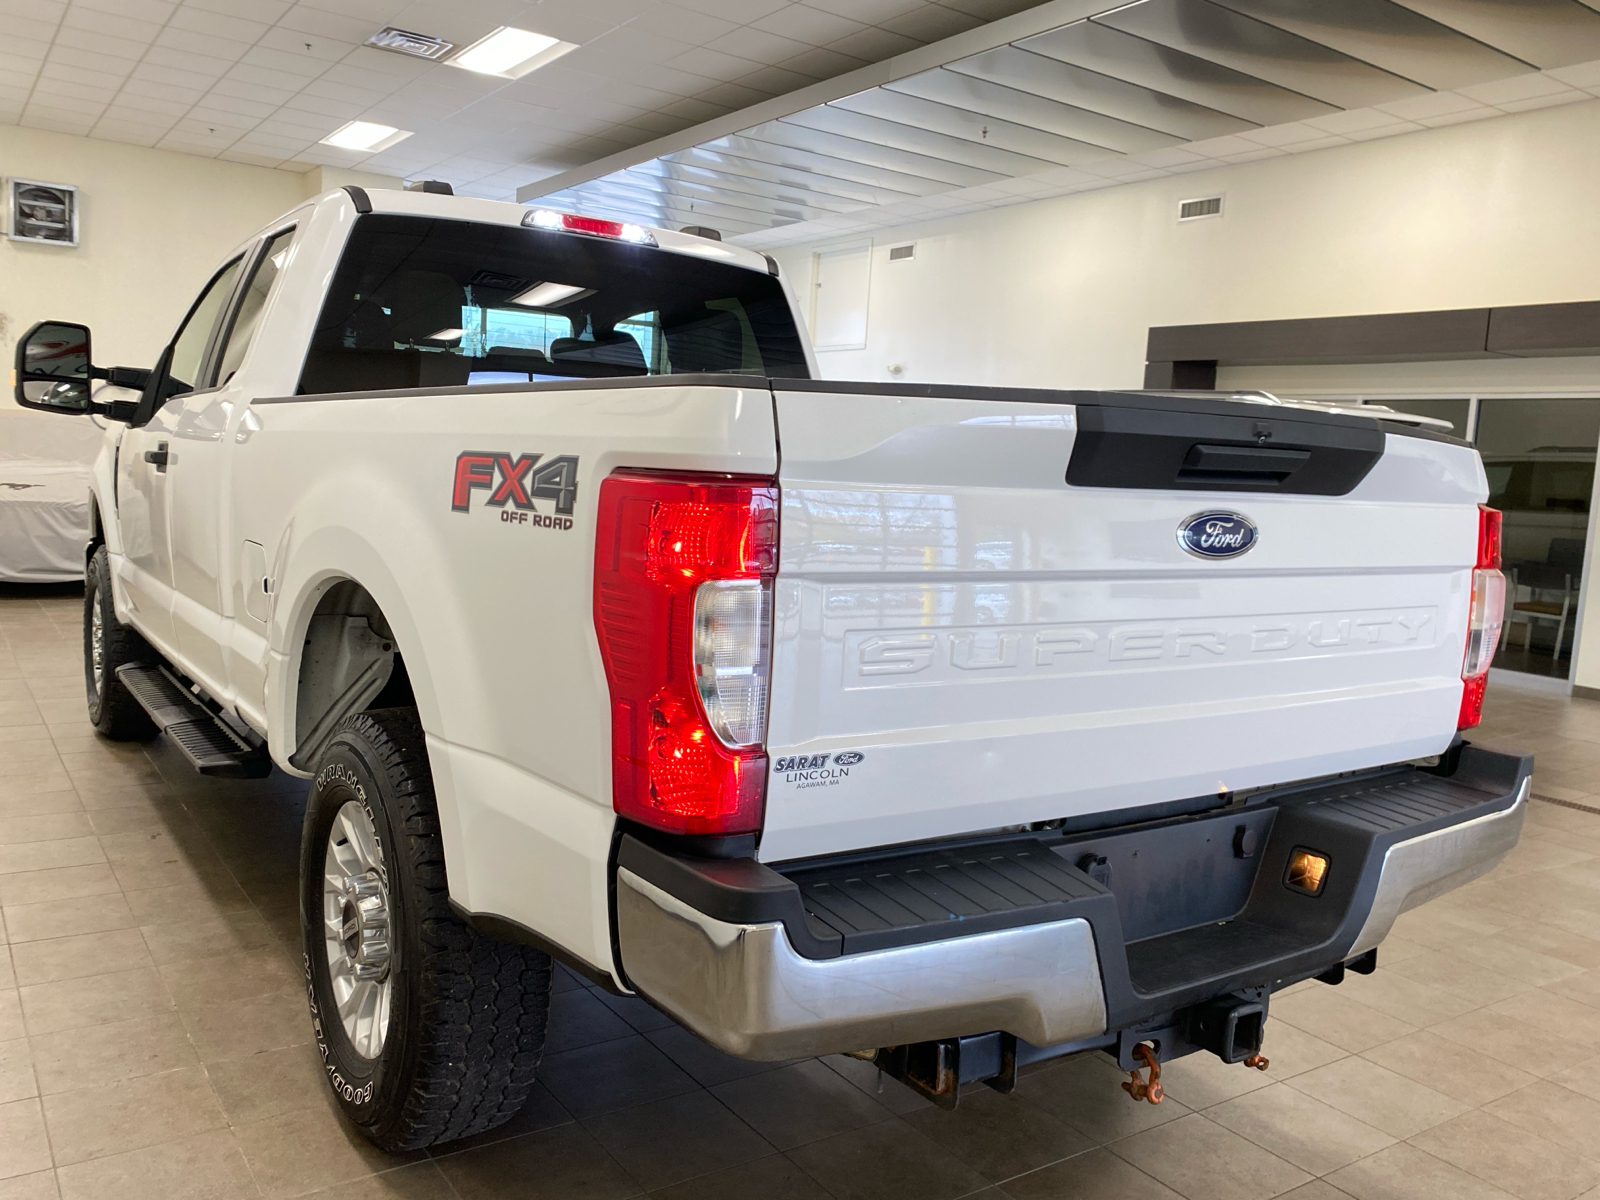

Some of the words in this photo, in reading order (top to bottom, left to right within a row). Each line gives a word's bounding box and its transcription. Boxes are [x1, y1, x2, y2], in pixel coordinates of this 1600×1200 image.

[451, 450, 580, 517] FX4
[500, 510, 528, 525] OFF
[533, 514, 574, 531] ROAD
[1200, 520, 1245, 548] Ford
[858, 626, 1228, 677] SUPER
[1251, 614, 1432, 653] DUTY
[773, 753, 831, 773] SARAT
[838, 752, 860, 764] Ford
[786, 768, 849, 783] LINCOLN
